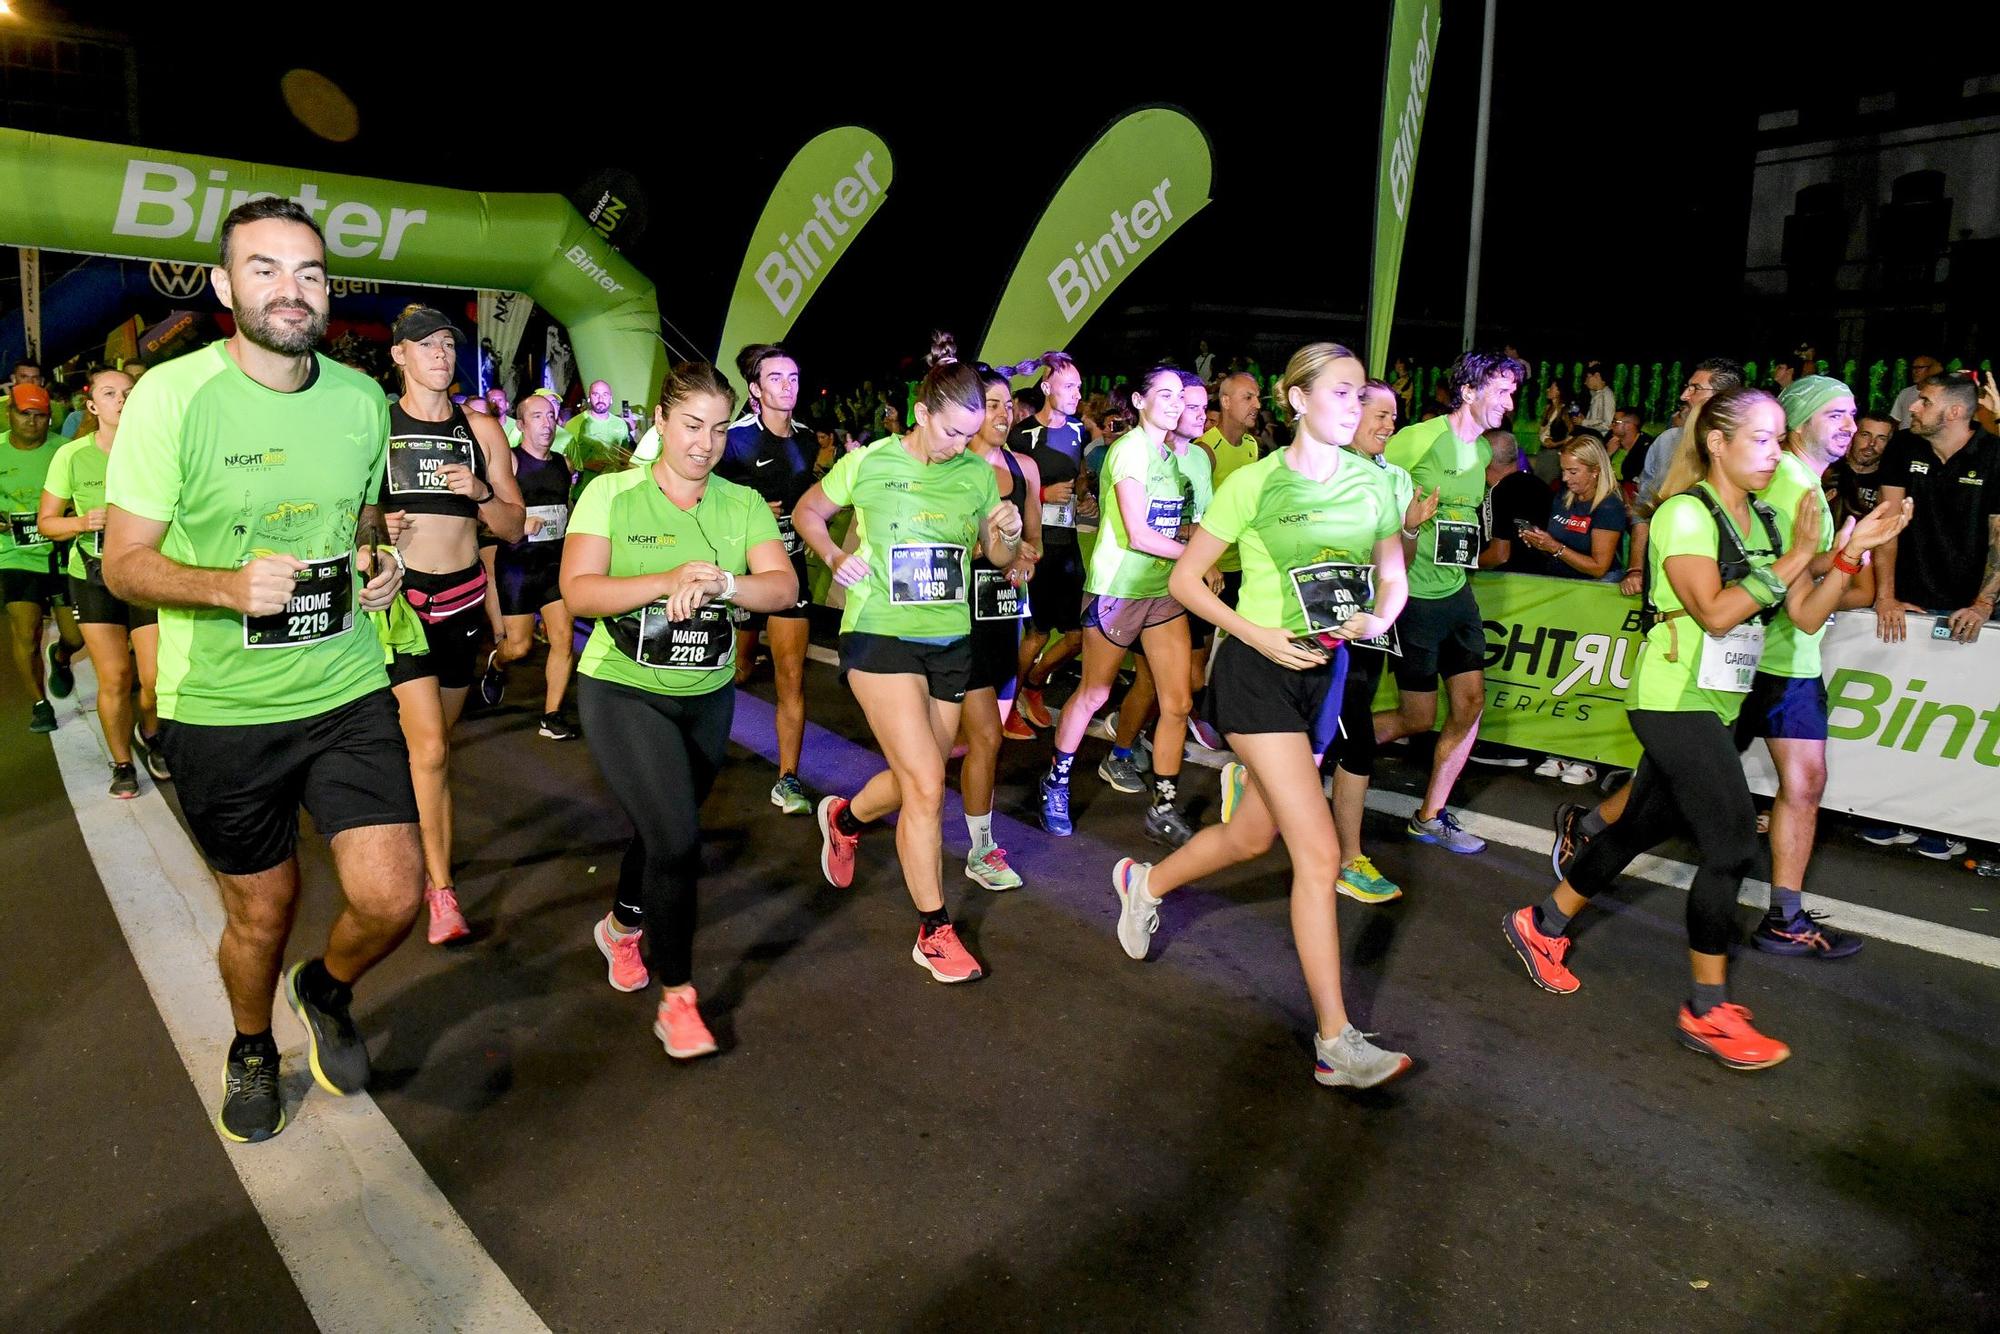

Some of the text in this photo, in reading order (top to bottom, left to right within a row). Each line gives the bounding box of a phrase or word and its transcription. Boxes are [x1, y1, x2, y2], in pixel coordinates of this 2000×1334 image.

[1390, 4, 1431, 222] Binter
[589, 190, 612, 223] Binter
[754, 150, 882, 318] Binter
[1047, 177, 1176, 323] Binter
[565, 245, 624, 294] Binter
[391, 441, 407, 449] 10K
[461, 445, 467, 454] 4
[416, 471, 448, 487] 1762
[913, 568, 948, 580] ANA MM
[917, 582, 946, 597] 1458
[1334, 589, 1355, 602] EVA
[648, 606, 666, 616] 10K
[997, 600, 1018, 614] 1473
[288, 611, 329, 637] 2219
[671, 629, 710, 645] MARTA
[669, 645, 706, 662] 2218
[1484, 688, 1592, 721] ERIES
